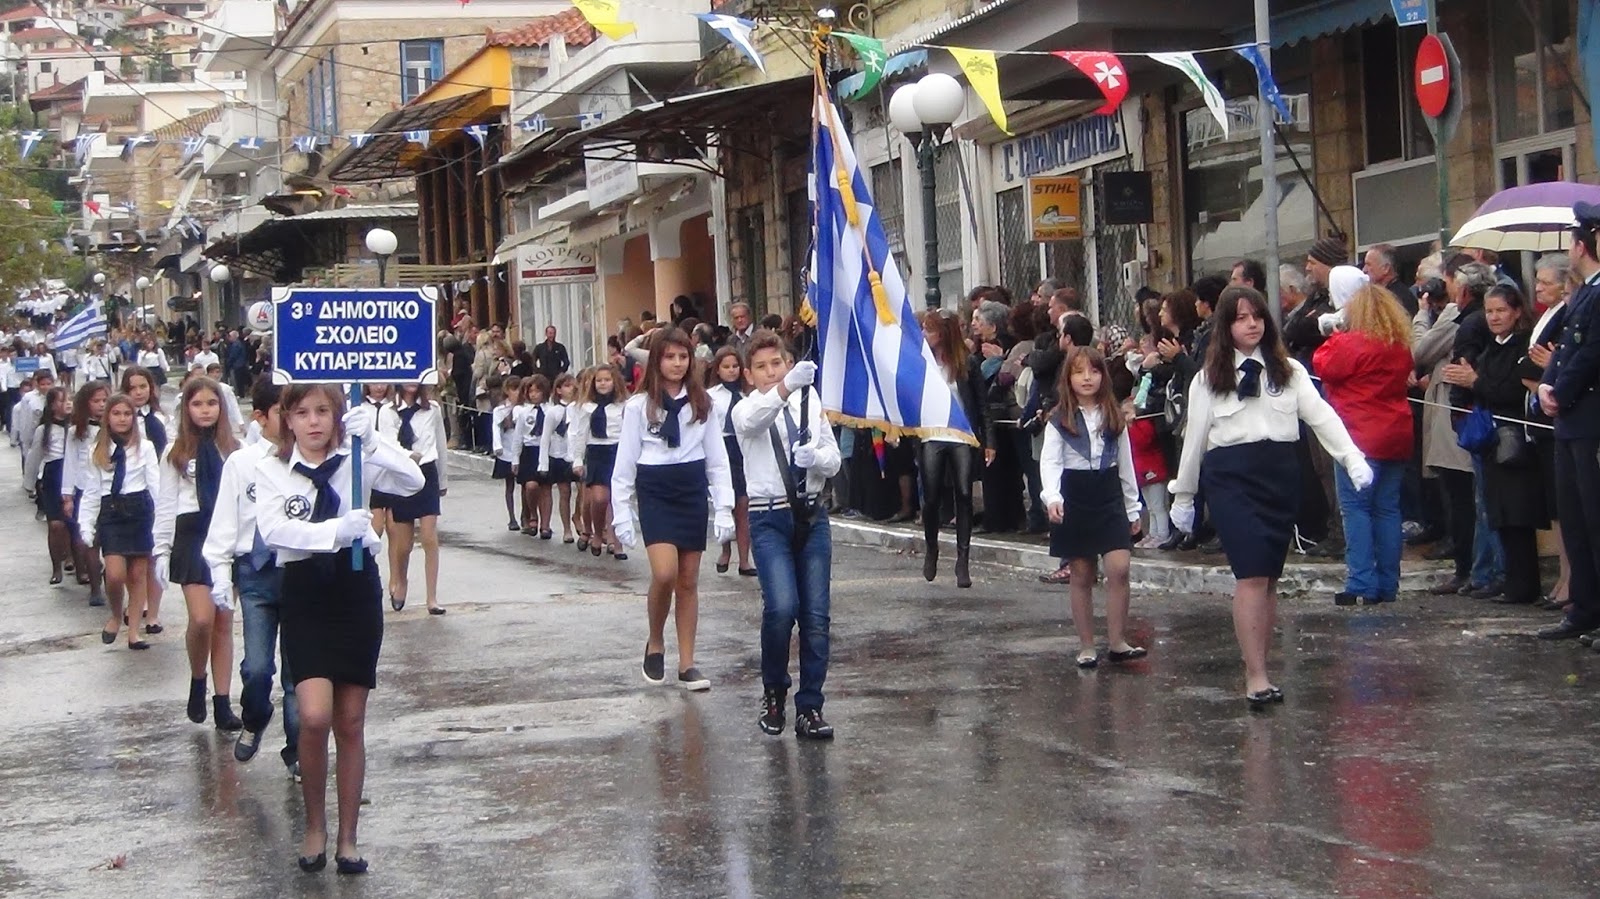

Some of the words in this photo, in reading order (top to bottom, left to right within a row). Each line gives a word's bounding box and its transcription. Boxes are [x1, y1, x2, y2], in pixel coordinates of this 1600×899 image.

[1033, 183, 1076, 195] STIHL
[1033, 229, 1057, 238] Chain
[525, 247, 592, 265] ΚΟΥΡΕΙΟ
[319, 300, 419, 320] ΔΗΜΟΤΙΚΟ
[315, 325, 398, 345] ΣΧΟΛΕΙΟ
[295, 351, 417, 371] ΚΥΠΑΡΙΣΣΙΑΣ
